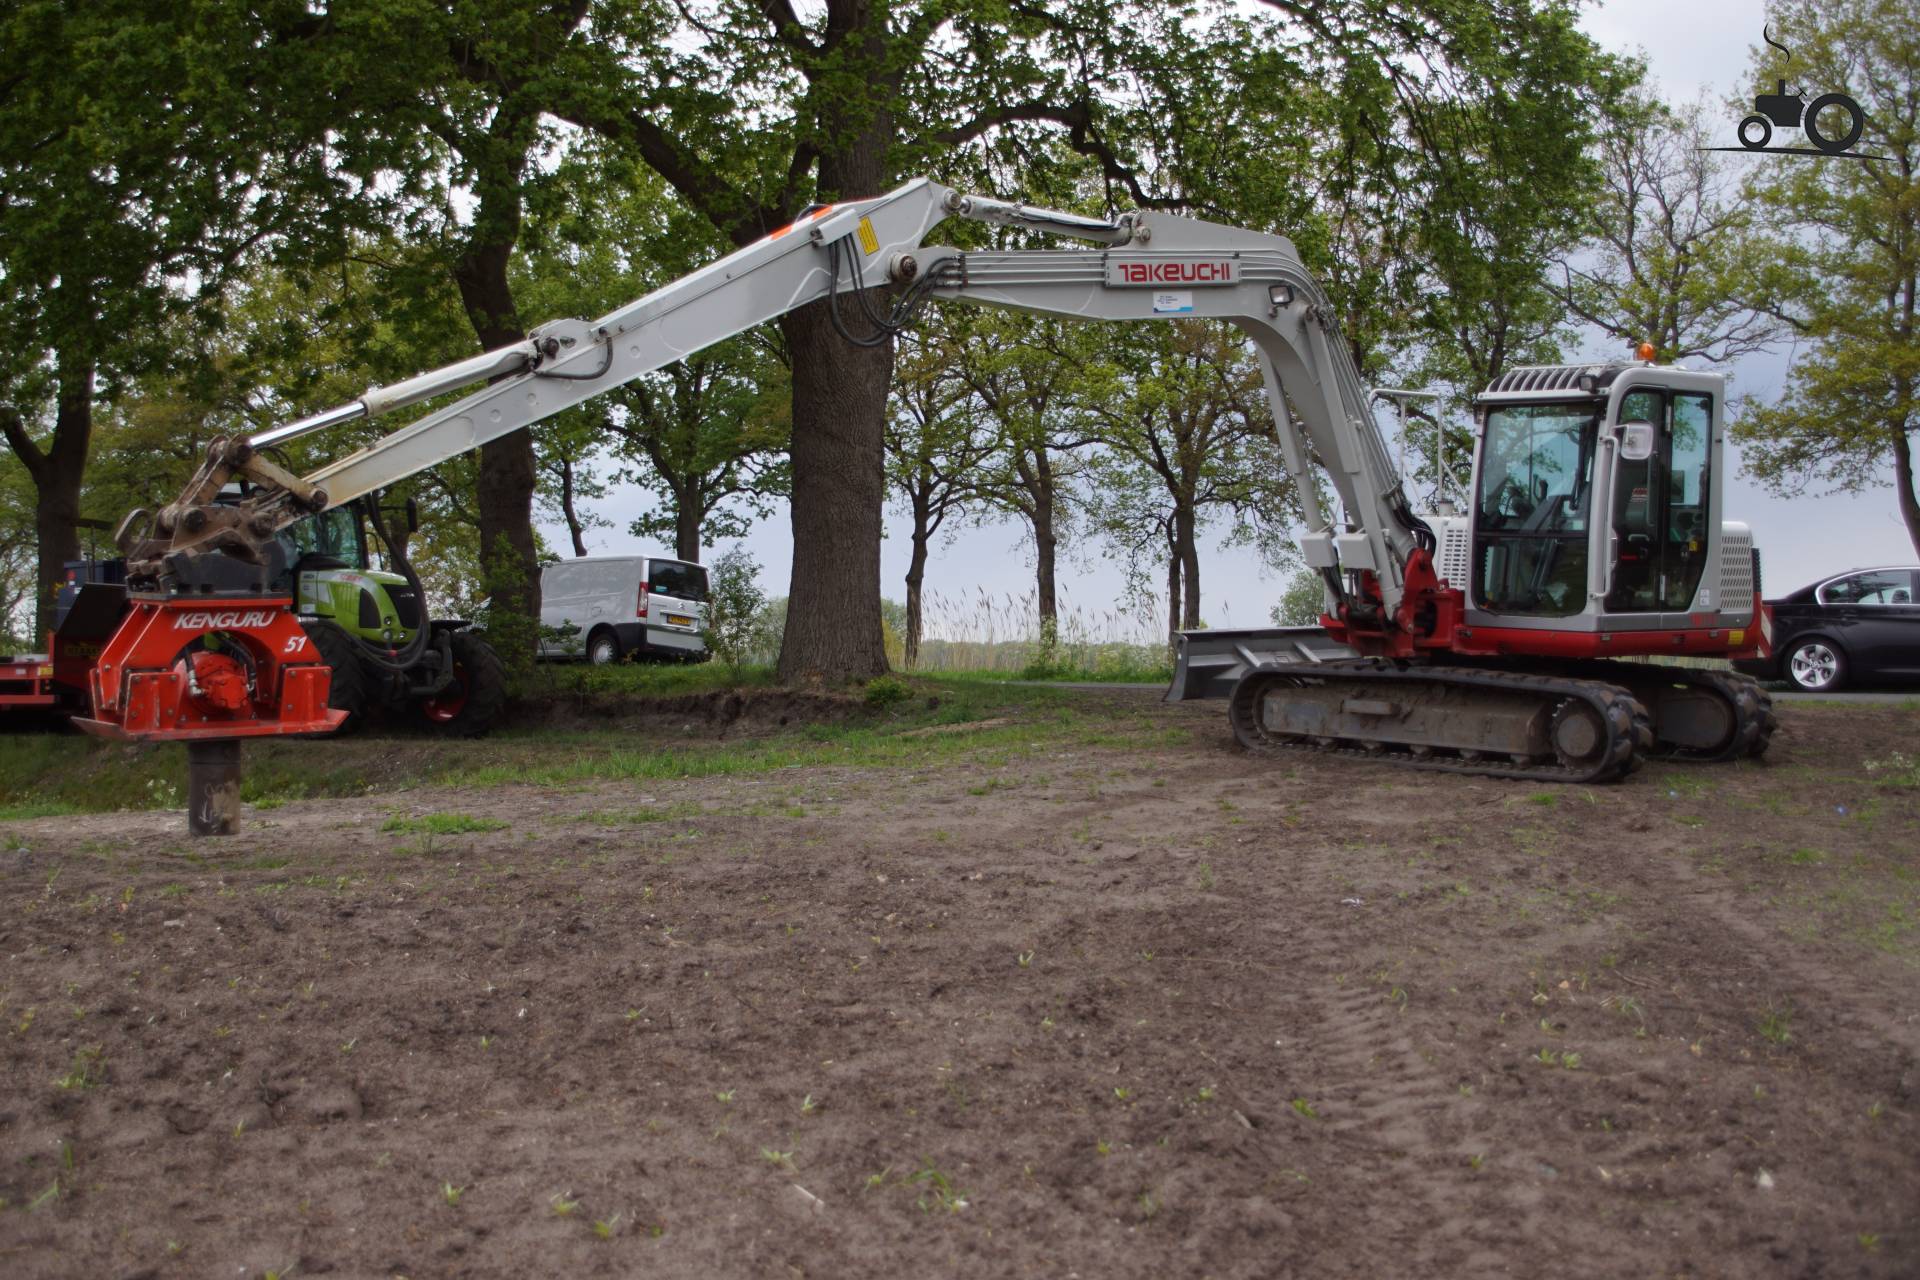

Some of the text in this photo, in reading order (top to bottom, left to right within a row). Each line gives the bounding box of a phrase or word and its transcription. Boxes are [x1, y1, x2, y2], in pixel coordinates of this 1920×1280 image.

[1118, 263, 1230, 282] TAKEUCHI
[174, 612, 275, 629] KENGURU
[284, 636, 307, 652] 51
